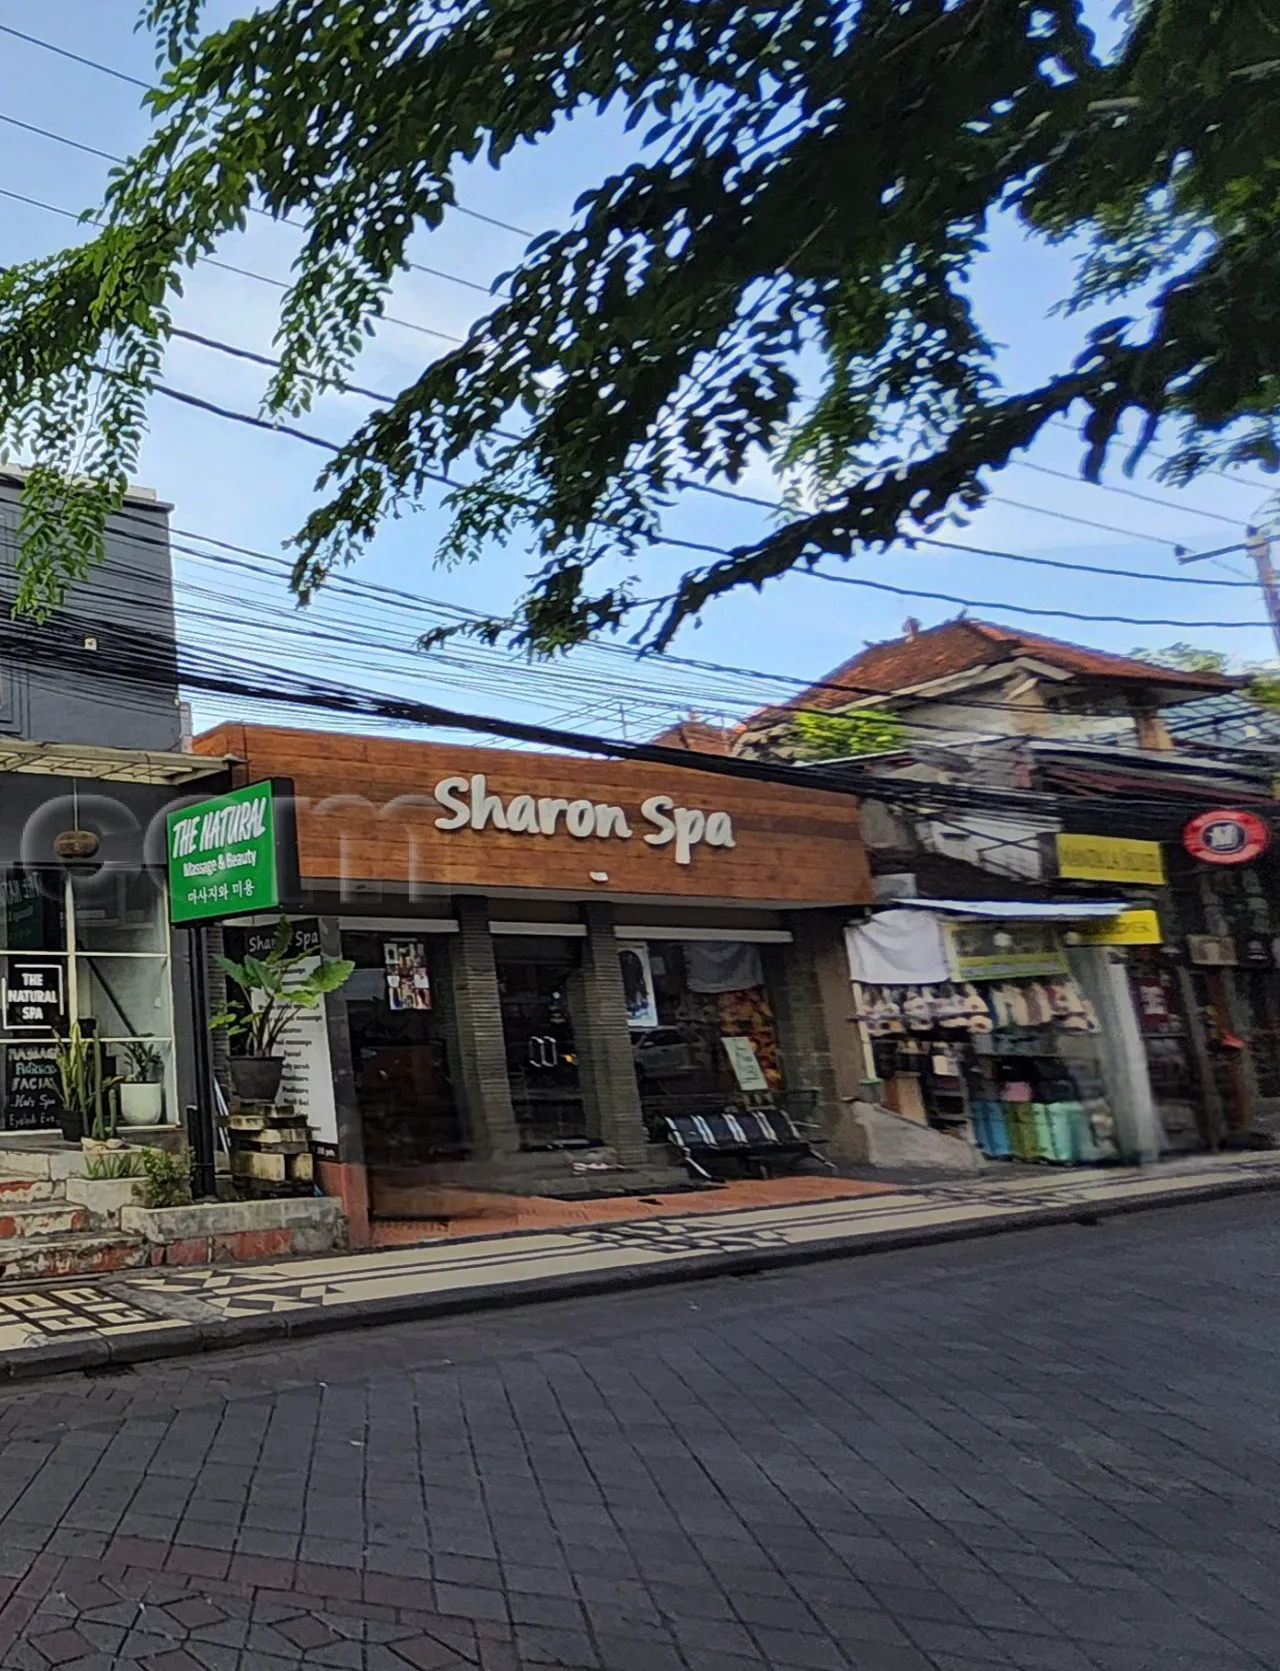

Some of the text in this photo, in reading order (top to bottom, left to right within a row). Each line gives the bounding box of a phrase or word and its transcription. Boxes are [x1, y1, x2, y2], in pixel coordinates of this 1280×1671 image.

[173, 797, 266, 858] THE NATURAL
[434, 774, 736, 864] Sharon Spa
[183, 849, 257, 877] Massage & Beauty
[188, 879, 255, 905] 마사지와 미용
[295, 931, 319, 951] Spa
[21, 973, 43, 986] THE
[8, 990, 57, 1003] NATURAL
[22, 1006, 43, 1019] SPA
